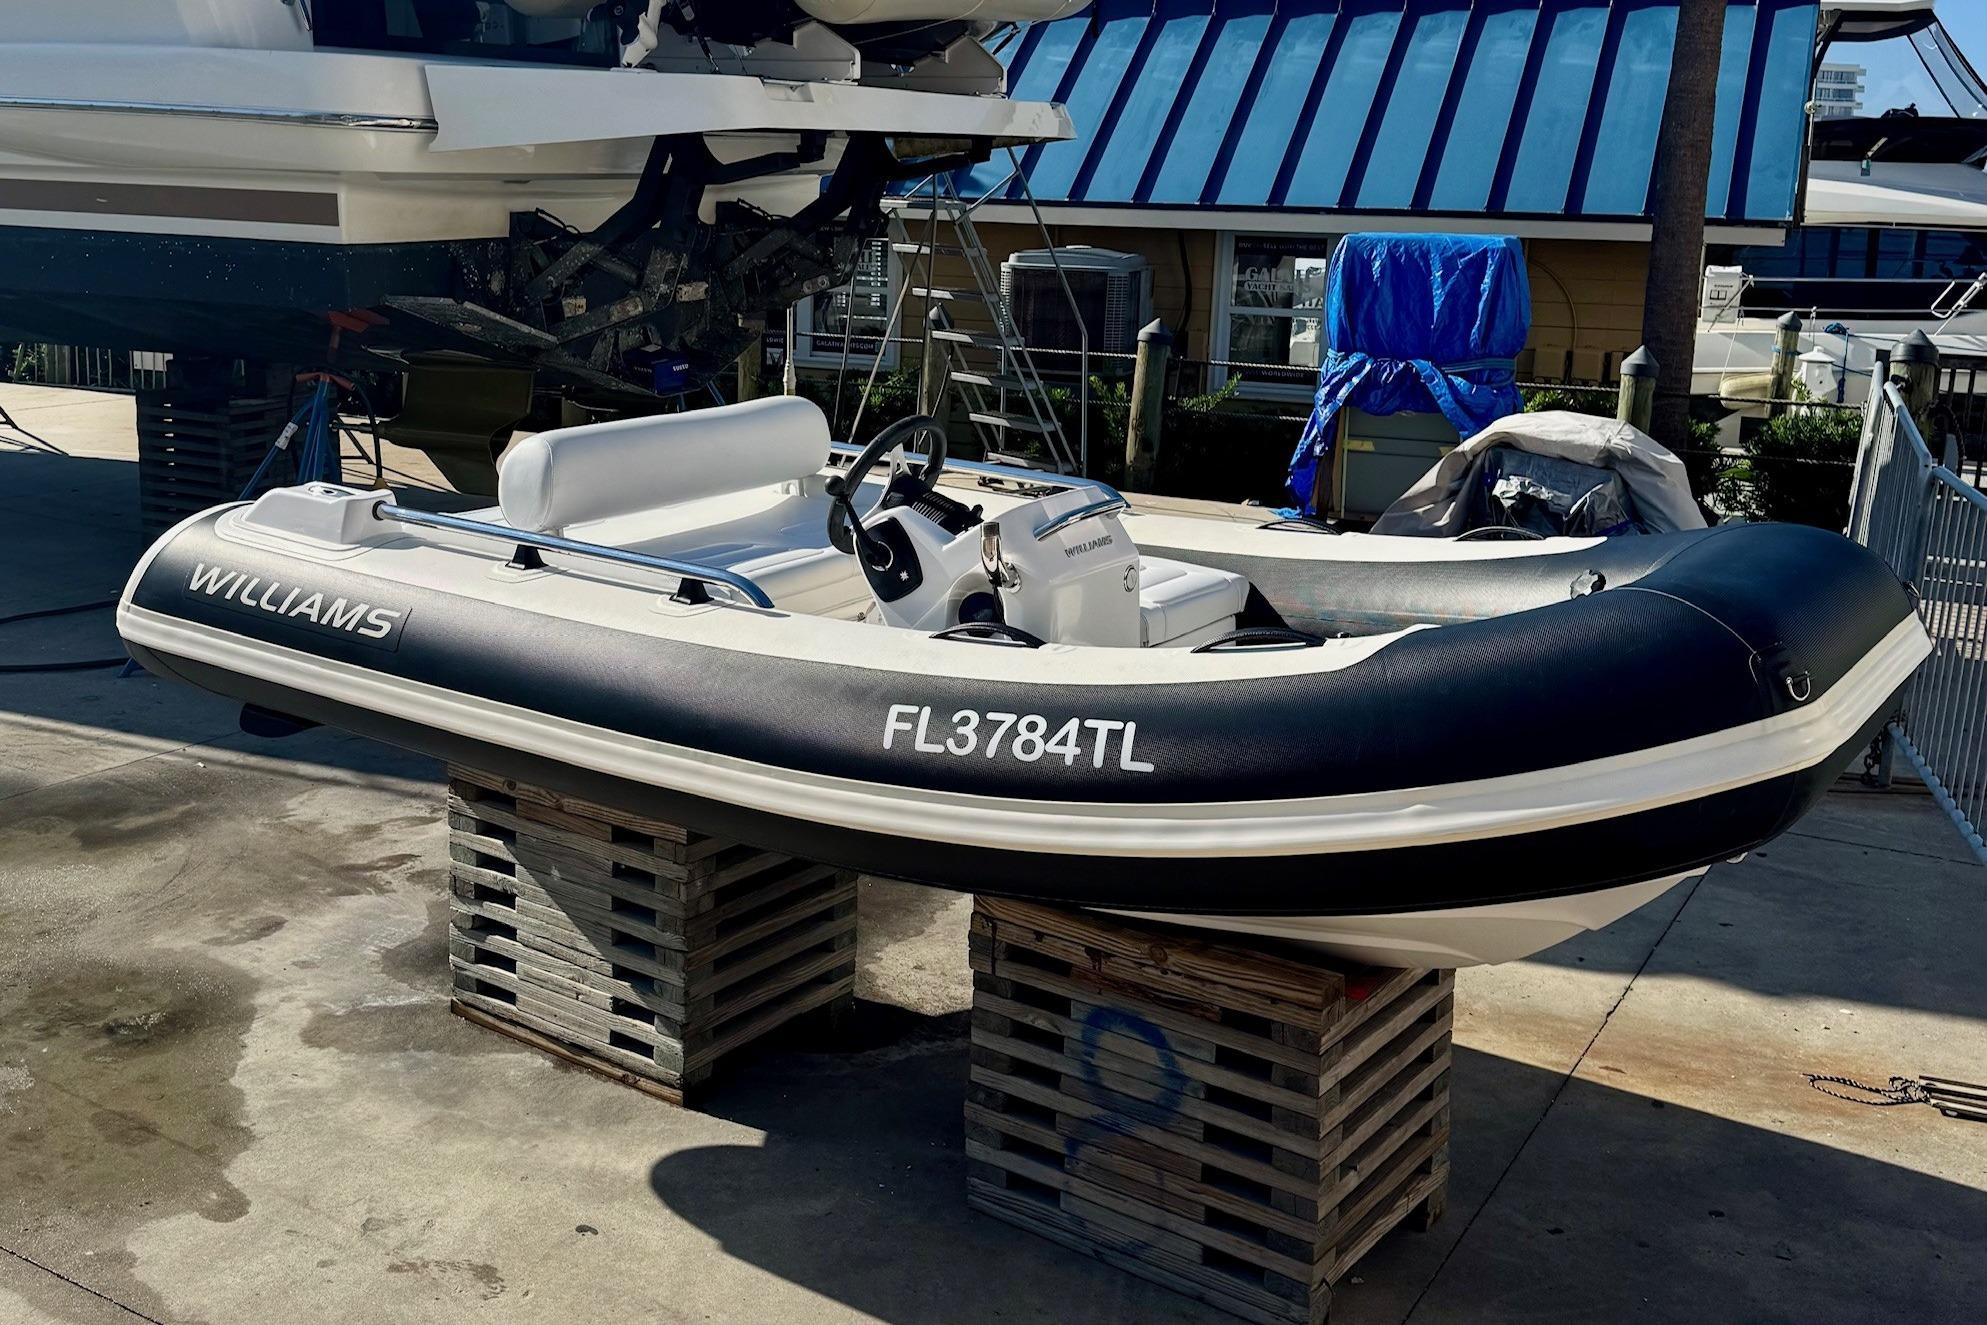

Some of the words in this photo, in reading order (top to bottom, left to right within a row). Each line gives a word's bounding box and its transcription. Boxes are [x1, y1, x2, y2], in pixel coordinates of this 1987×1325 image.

[1064, 535, 1113, 558] WILLIAMS
[188, 562, 401, 639] WILLIAMS
[882, 704, 1155, 773] FL3784TL
